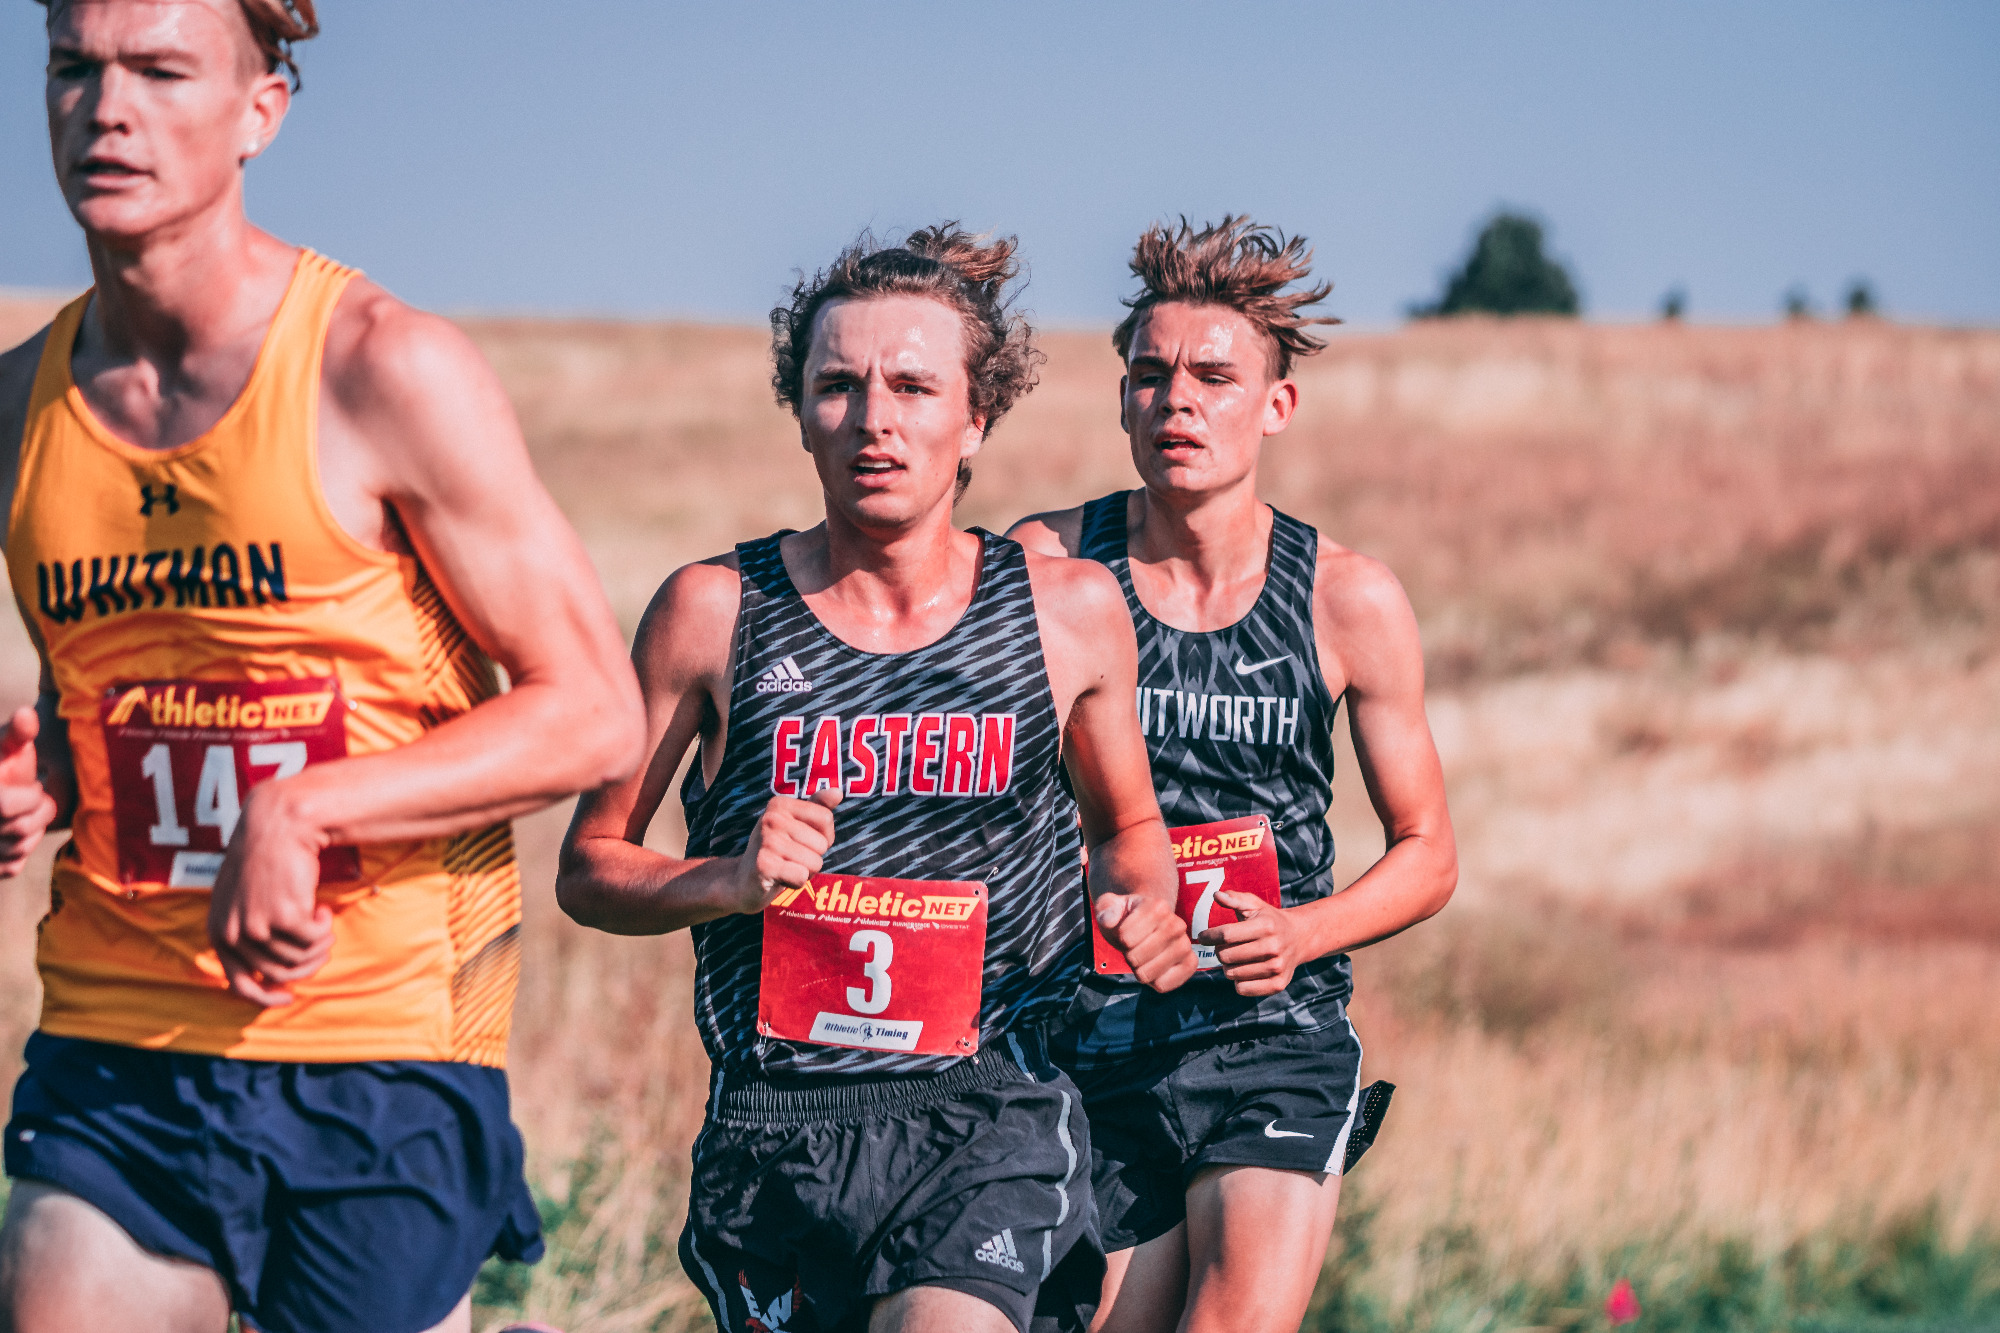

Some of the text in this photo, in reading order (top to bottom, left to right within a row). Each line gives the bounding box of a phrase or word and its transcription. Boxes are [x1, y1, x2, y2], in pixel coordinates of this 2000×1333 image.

[37, 542, 289, 624] WHITMAN
[756, 678, 812, 692] adidas
[770, 713, 1017, 798] EASTERN
[1185, 867, 1226, 940] 7
[846, 929, 894, 1015] 3
[876, 1027, 908, 1040] Timing
[975, 1249, 1024, 1273] adidas
